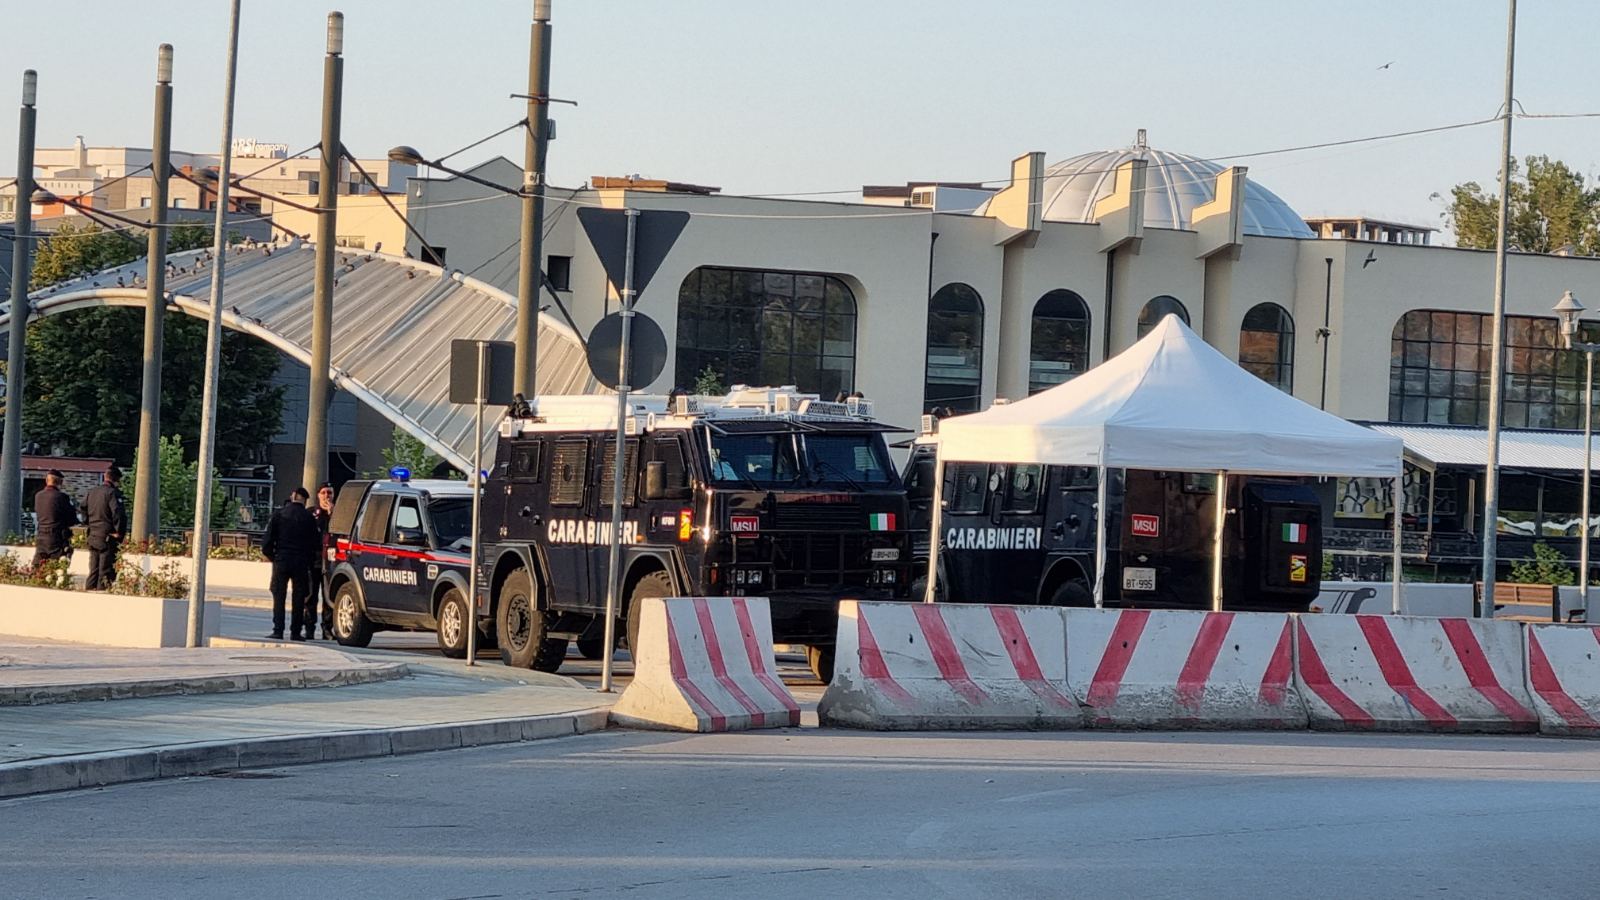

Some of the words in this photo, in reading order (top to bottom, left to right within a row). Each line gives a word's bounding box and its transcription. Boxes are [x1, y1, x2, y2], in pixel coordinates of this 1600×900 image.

[732, 521, 757, 532] MSU
[1133, 519, 1156, 532] MSU
[947, 527, 1042, 549] CARABINIERI
[363, 566, 417, 586] CARABINIERI
